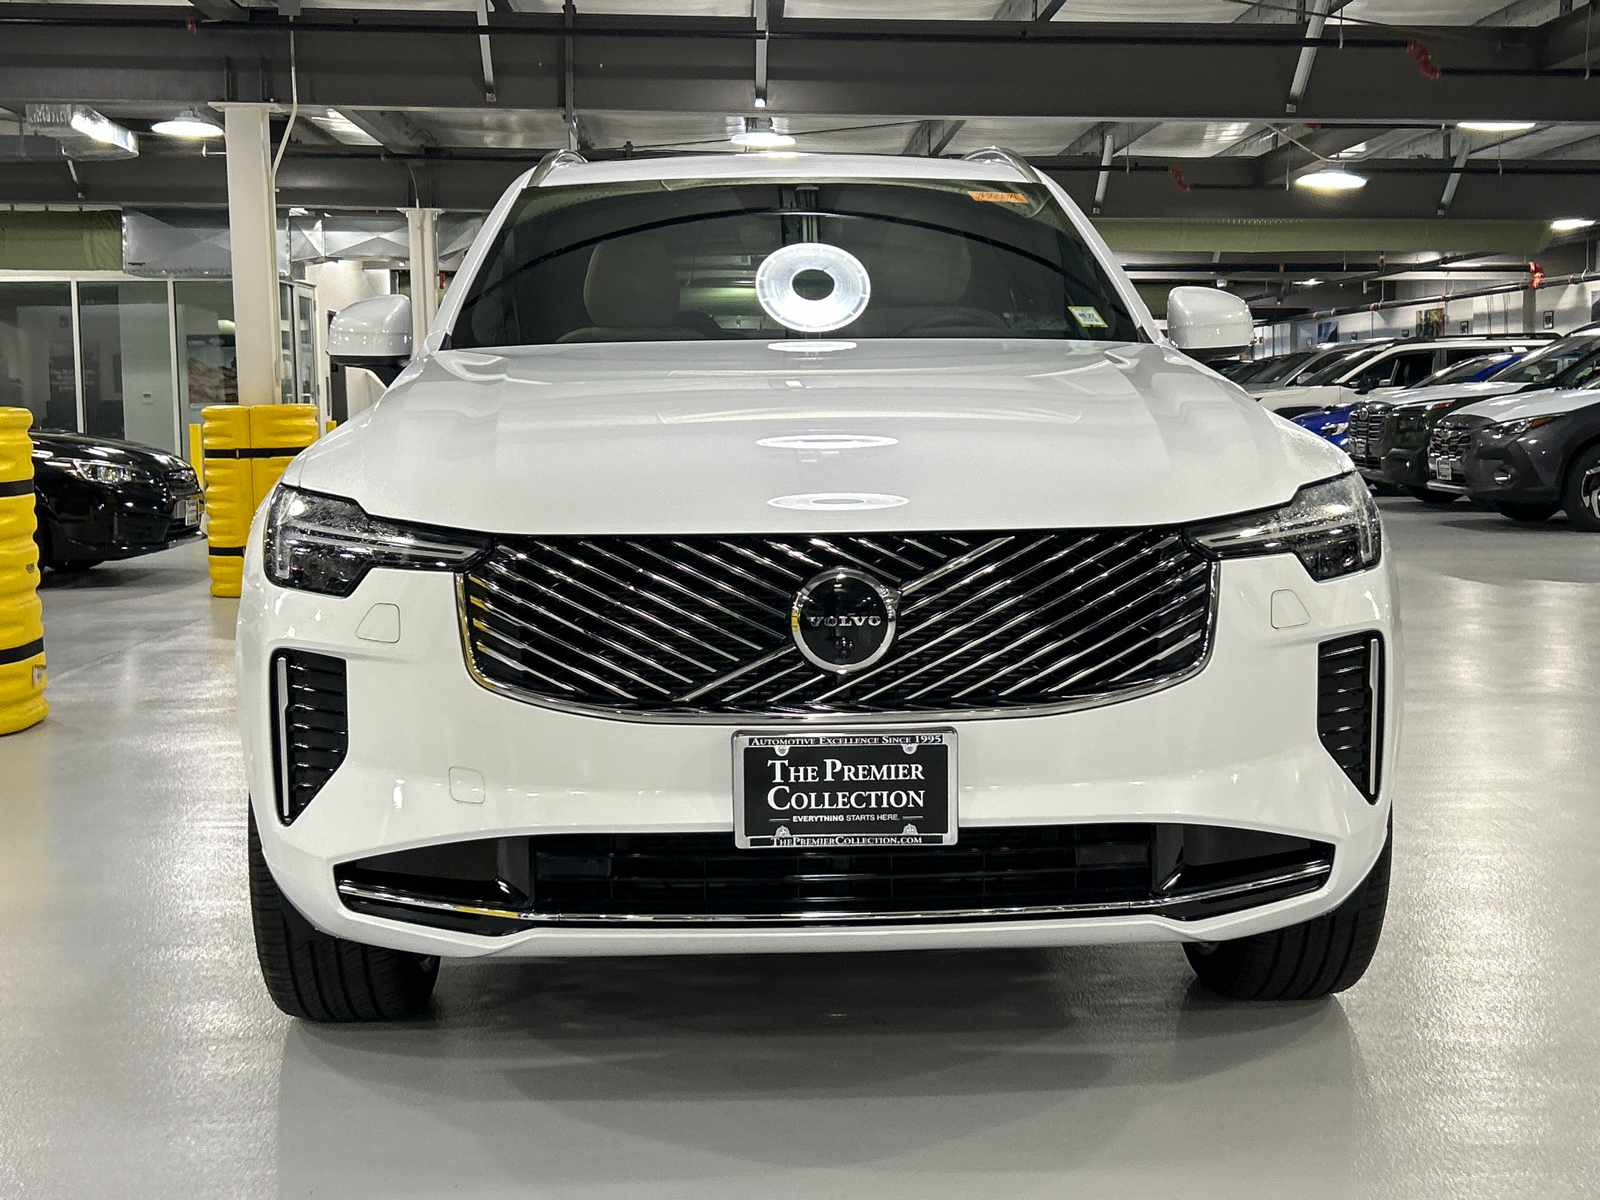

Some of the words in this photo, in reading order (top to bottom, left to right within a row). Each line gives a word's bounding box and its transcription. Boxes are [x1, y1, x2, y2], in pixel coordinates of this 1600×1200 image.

[807, 616, 881, 626] VOLVO
[915, 734, 942, 744] 1995
[767, 759, 819, 783] THE
[823, 759, 925, 782] PREMIER
[767, 785, 925, 811] COLLECTION
